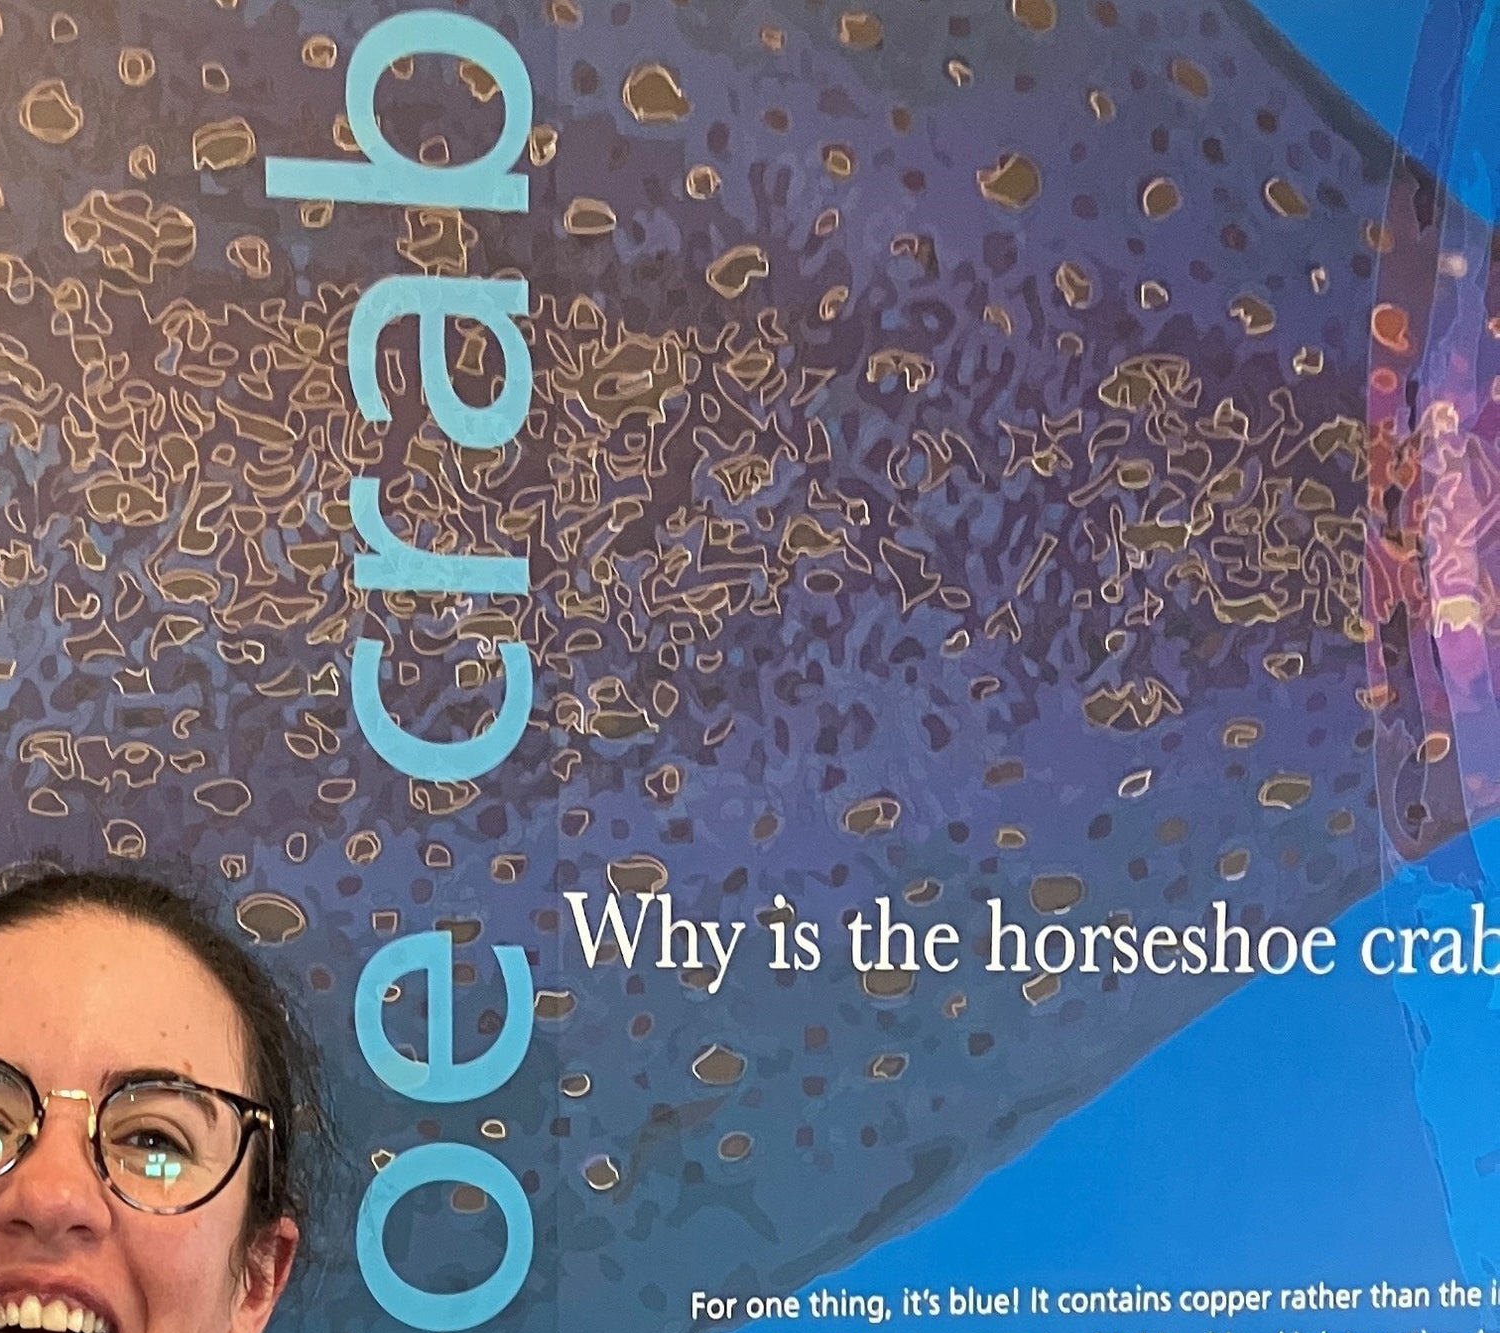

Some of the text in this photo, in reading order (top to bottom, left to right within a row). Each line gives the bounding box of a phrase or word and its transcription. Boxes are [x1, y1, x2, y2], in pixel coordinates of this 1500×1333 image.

[265, 8, 534, 784] crab
[562, 891, 1500, 994] Why is the horseshoe crab
[691, 1291, 738, 1320] For
[746, 1296, 800, 1319] one
[808, 1288, 892, 1323] thing,
[903, 1288, 941, 1316] it's
[949, 1286, 1019, 1315] blue!
[1031, 1287, 1049, 1314] It
[1057, 1284, 1172, 1314] contains
[1179, 1290, 1273, 1318] copper
[1281, 1281, 1363, 1310] rather
[1369, 1281, 1430, 1309] than
[1438, 1279, 1482, 1308] the
